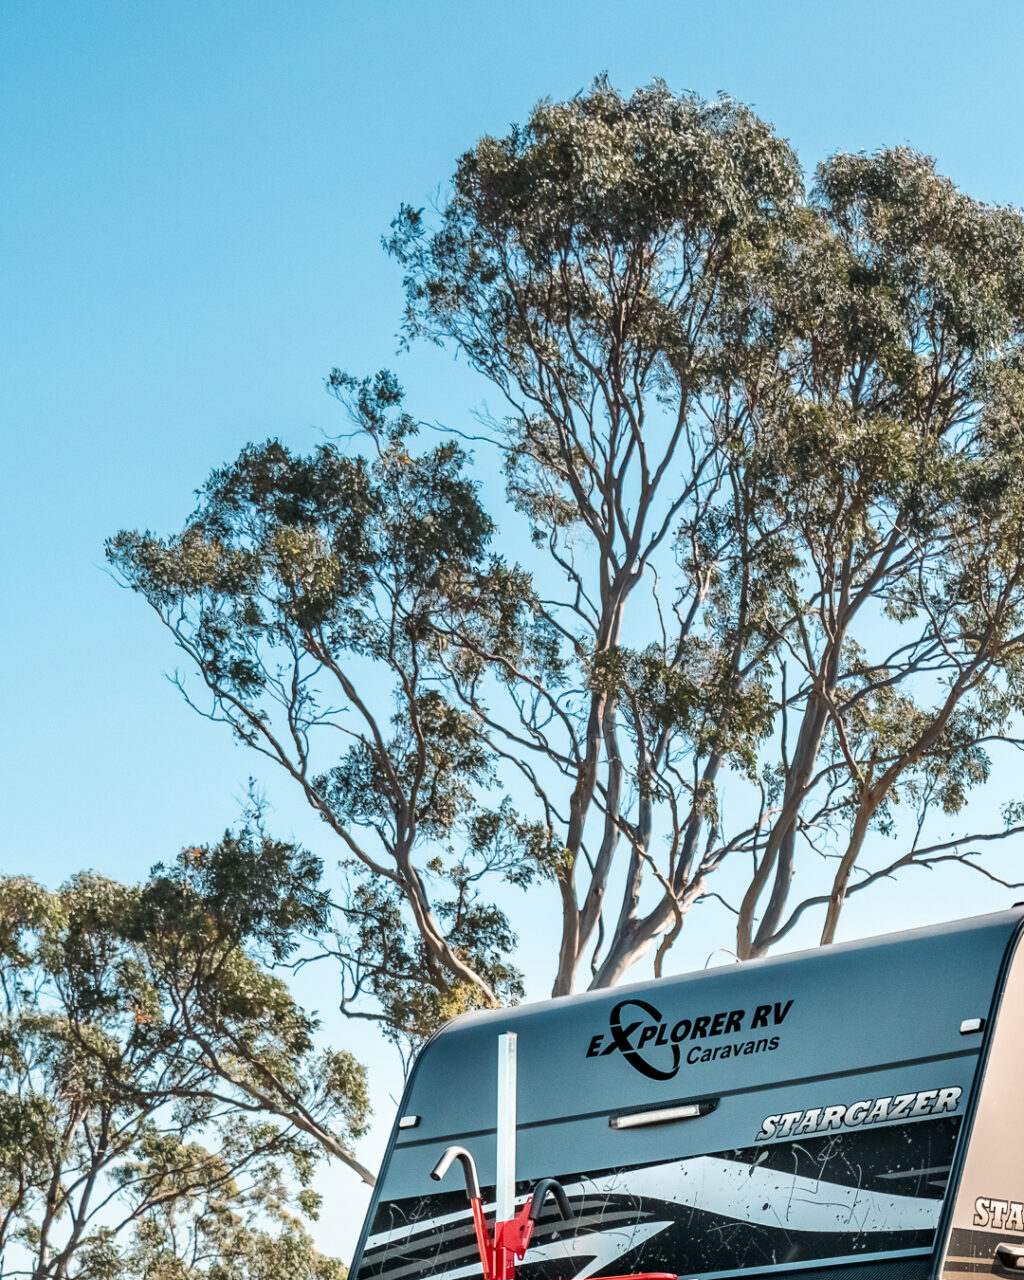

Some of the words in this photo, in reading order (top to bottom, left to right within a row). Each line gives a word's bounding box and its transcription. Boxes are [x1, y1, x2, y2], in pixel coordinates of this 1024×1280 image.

[586, 1009, 745, 1058] EXPLORER
[750, 1000, 795, 1030] RV
[686, 1036, 781, 1064] Caravans
[754, 1086, 963, 1142] STARGAZER
